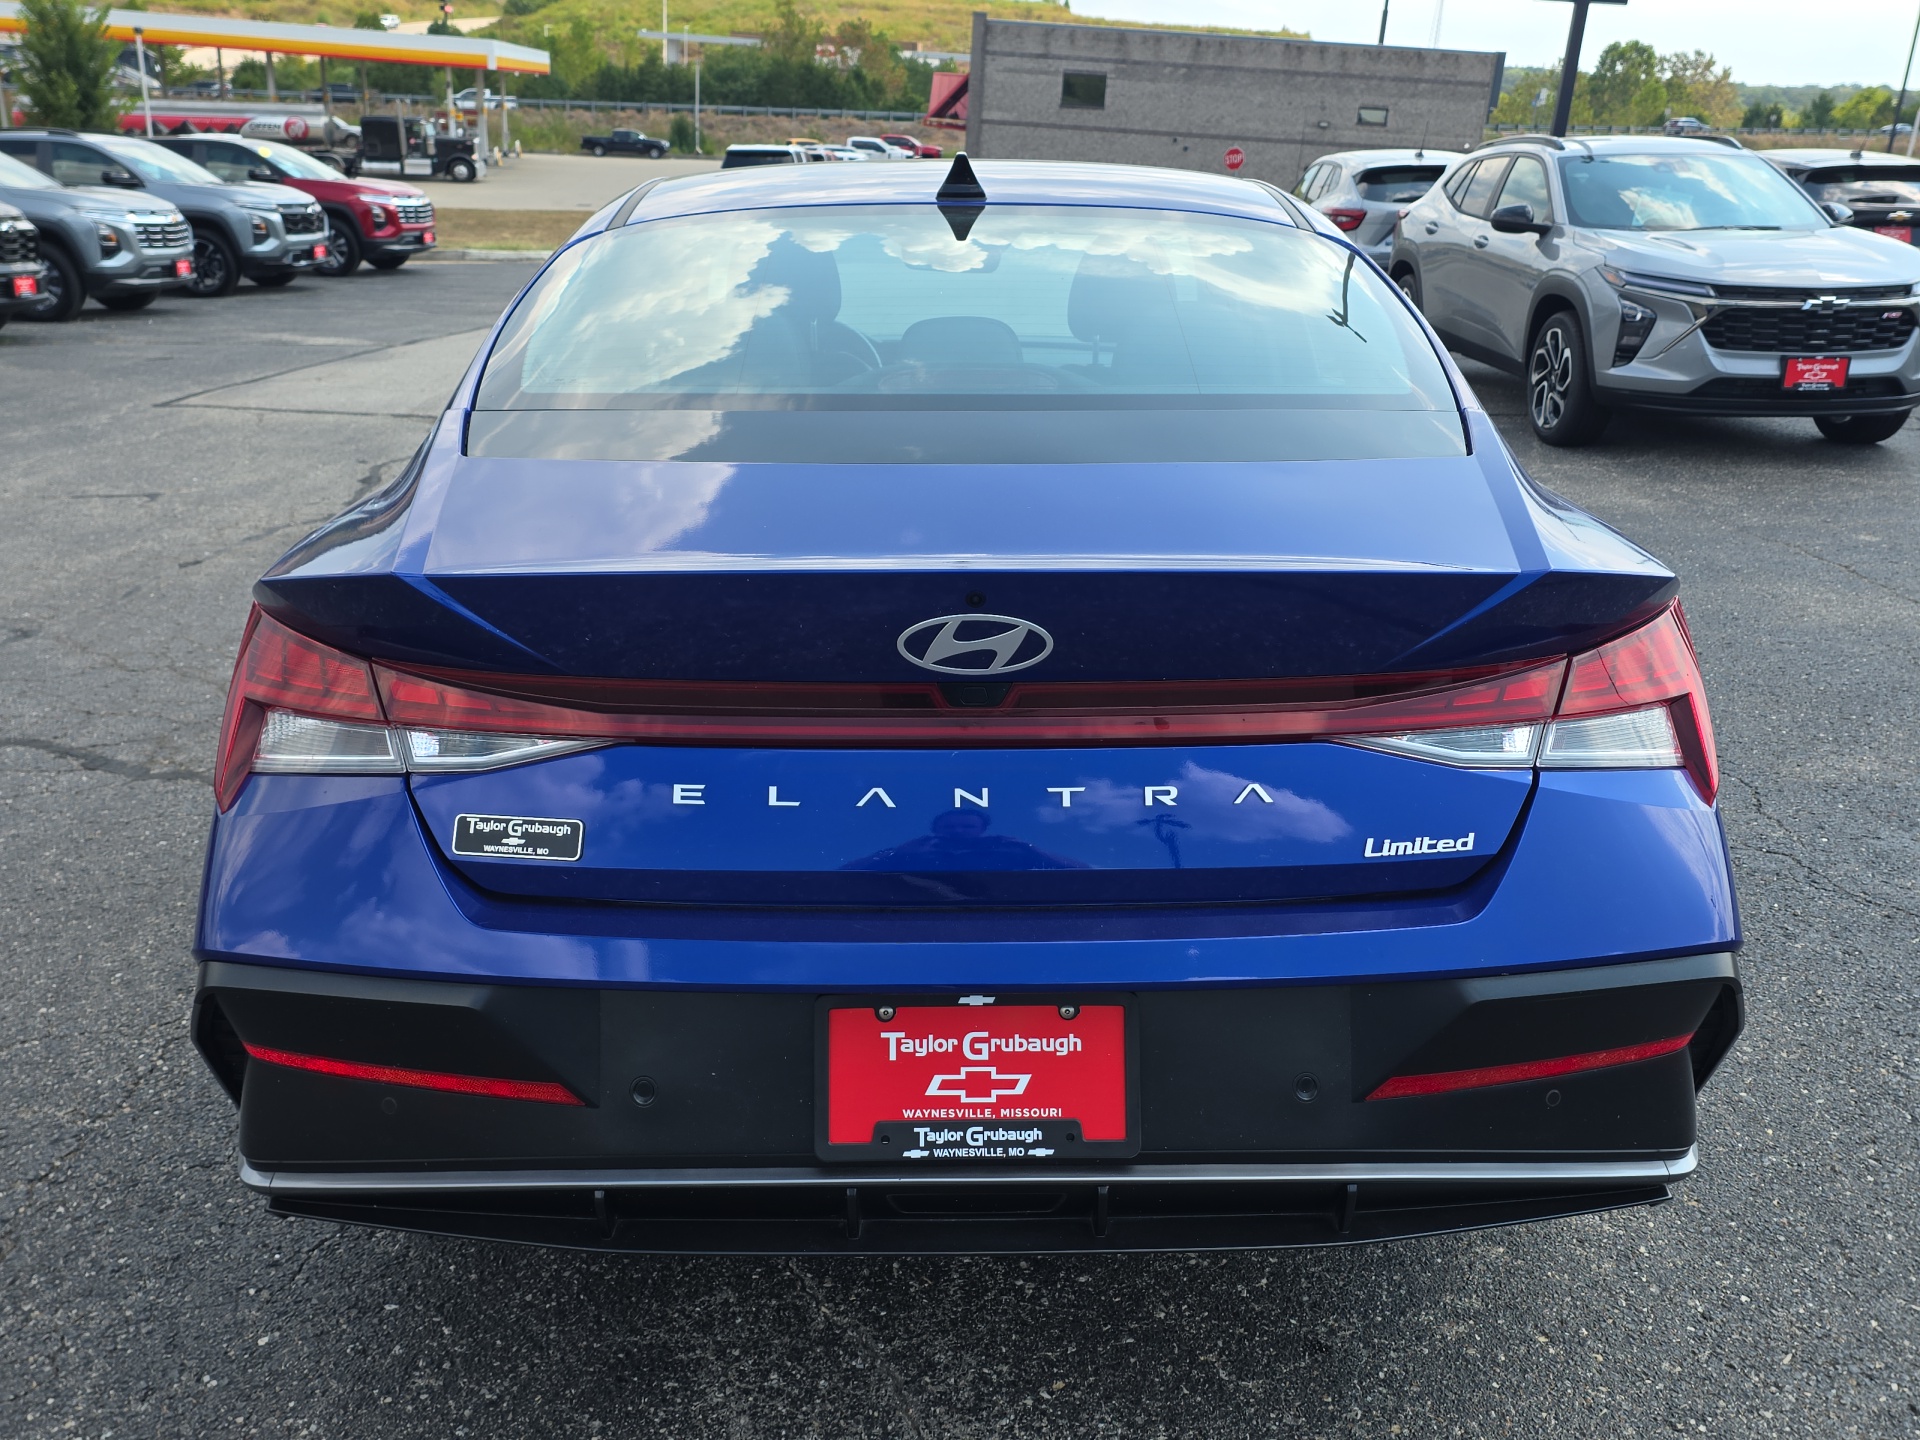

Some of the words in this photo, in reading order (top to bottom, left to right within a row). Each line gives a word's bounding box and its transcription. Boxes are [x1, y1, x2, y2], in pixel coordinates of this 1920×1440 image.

[1225, 153, 1243, 164] STOP
[672, 783, 1274, 808] ELANTRA
[466, 817, 506, 834] Taylor
[507, 819, 571, 837] Grubaugh
[483, 845, 536, 855] WAYNESVILLE,
[1364, 832, 1475, 858] Limited
[880, 1031, 958, 1061] Taylor
[962, 1031, 1082, 1060] Grubaugh
[902, 1108, 996, 1119] WAYNESVILLE,
[1000, 1107, 1063, 1118] MISSOURI
[913, 1127, 964, 1147] Taylor
[965, 1126, 1043, 1146] Grubaugh
[933, 1147, 1006, 1158] WAYNESVILLE,
[1008, 1147, 1025, 1157] MO
